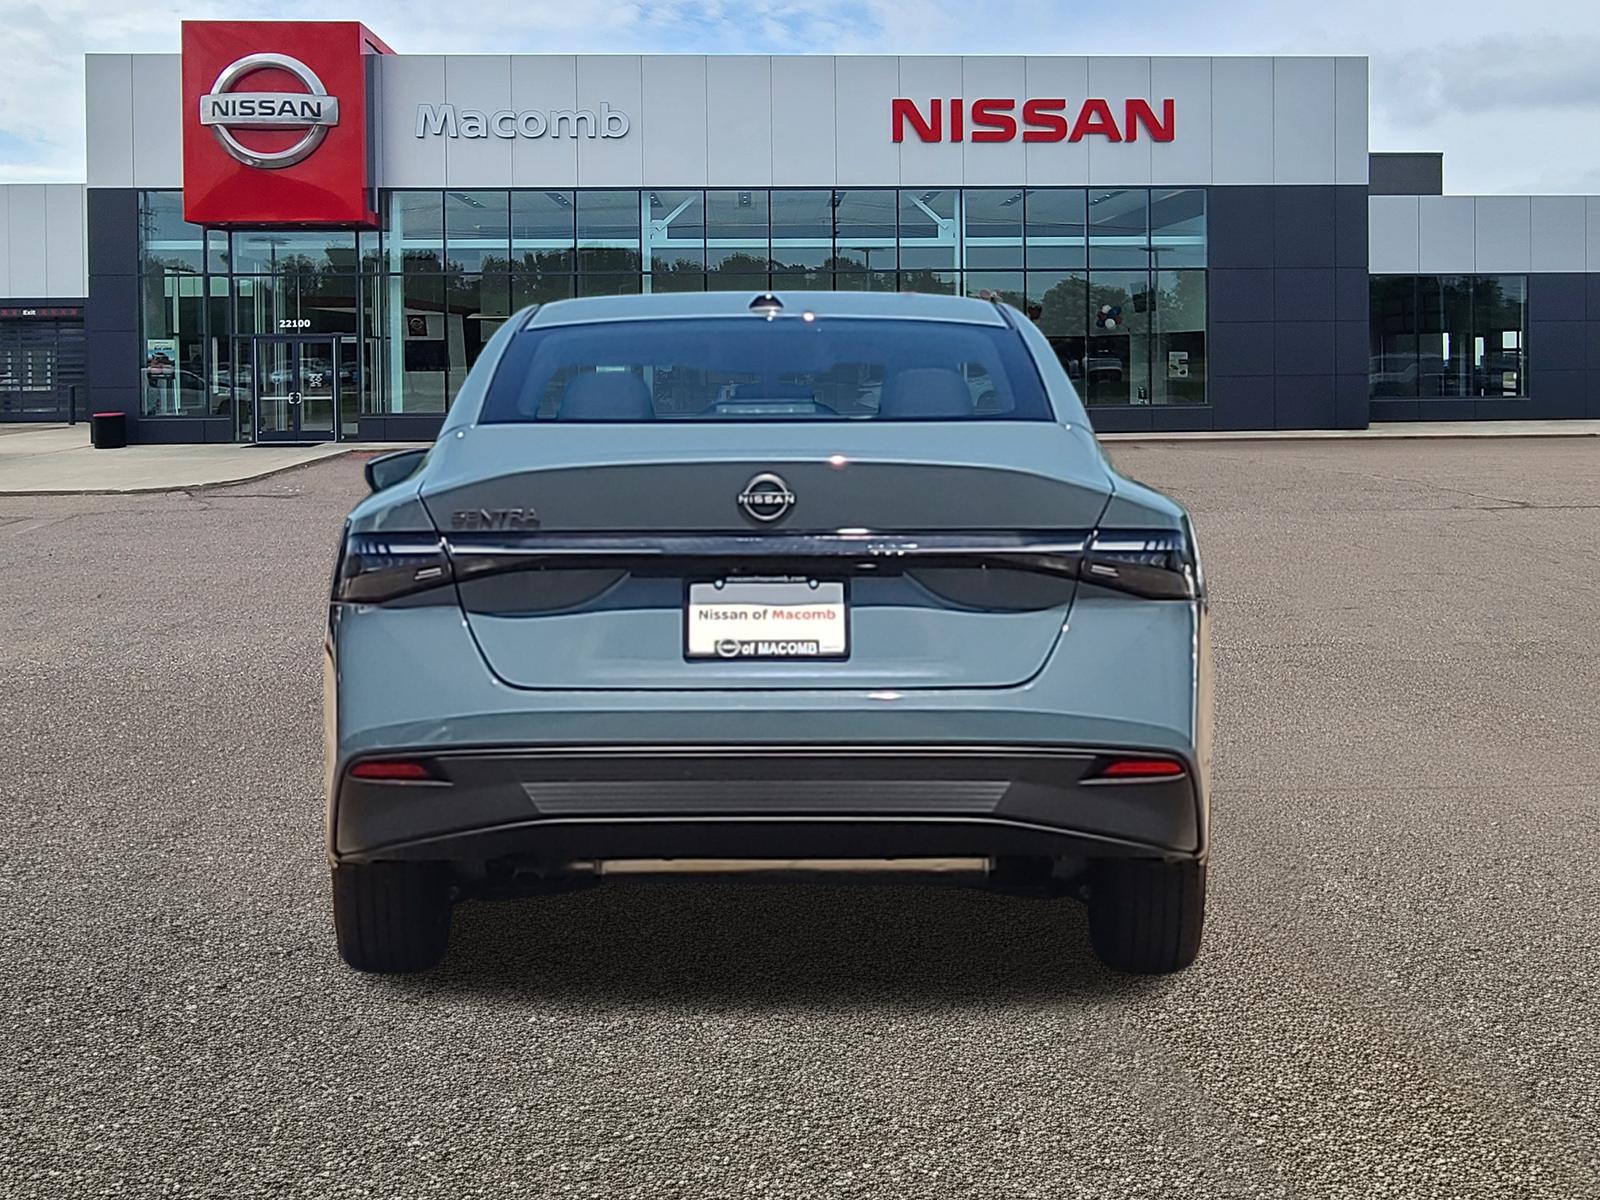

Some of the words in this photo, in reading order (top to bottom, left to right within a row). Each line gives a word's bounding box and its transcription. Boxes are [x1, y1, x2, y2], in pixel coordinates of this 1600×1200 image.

[212, 99, 322, 118] NISSAN
[415, 101, 630, 139] Macomb
[892, 98, 1175, 143] NISSAN
[279, 319, 311, 328] 22100
[738, 494, 795, 504] NISSAN
[451, 508, 541, 529] SENTRA
[698, 609, 748, 620] Nissan
[752, 609, 768, 620] of
[772, 609, 836, 620] Macomb
[741, 642, 755, 655] of
[758, 642, 818, 655] MACOMB
